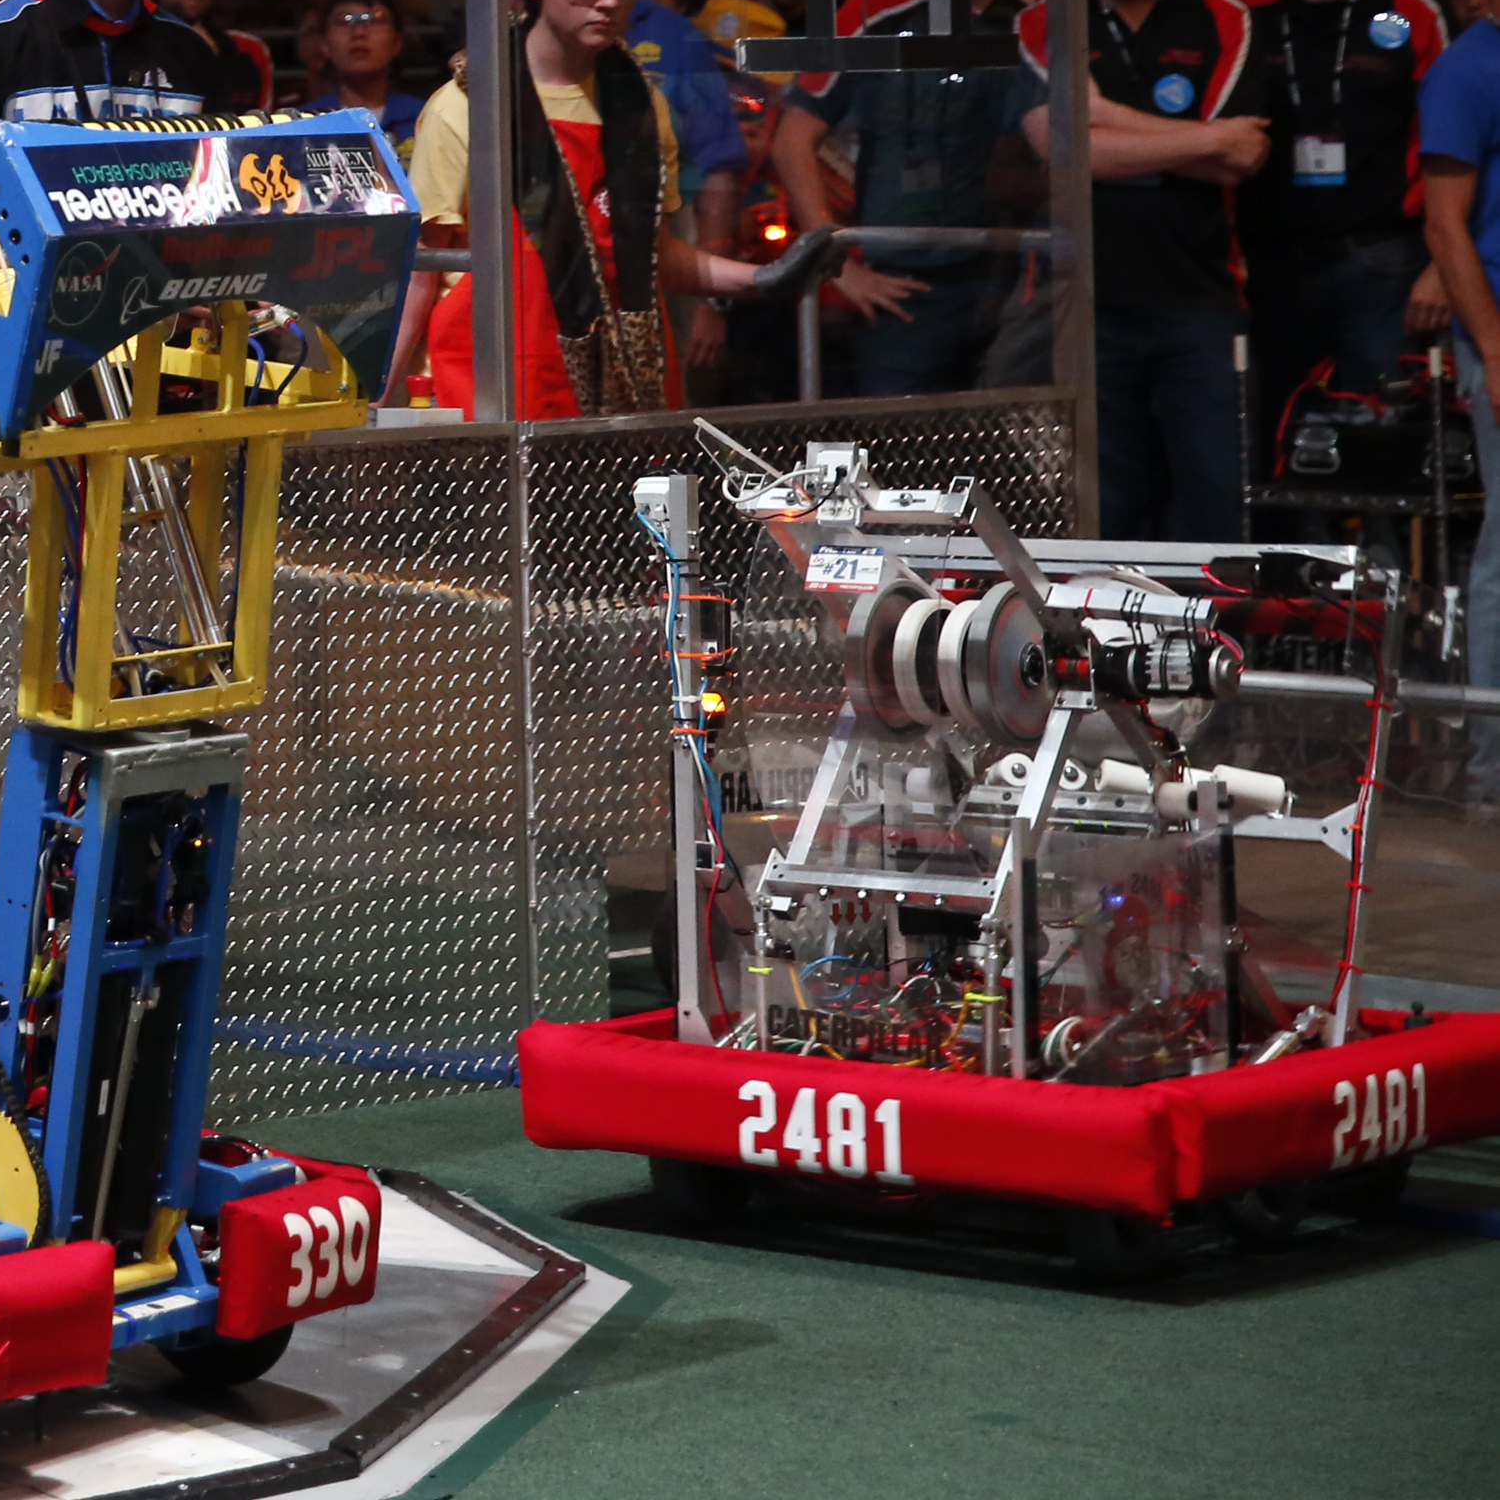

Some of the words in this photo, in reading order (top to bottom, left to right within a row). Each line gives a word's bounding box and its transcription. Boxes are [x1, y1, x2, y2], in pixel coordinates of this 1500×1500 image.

[71, 164, 124, 185] BEACH
[124, 160, 194, 182] HERMOSA
[291, 225, 387, 280] JPL
[55, 274, 102, 293] NASA
[157, 273, 268, 301] BOEING
[34, 339, 64, 374] JF
[821, 557, 860, 581] #21
[1332, 1062, 1430, 1168] 2481
[737, 1079, 915, 1186] 2481
[283, 1196, 373, 1308] 330
